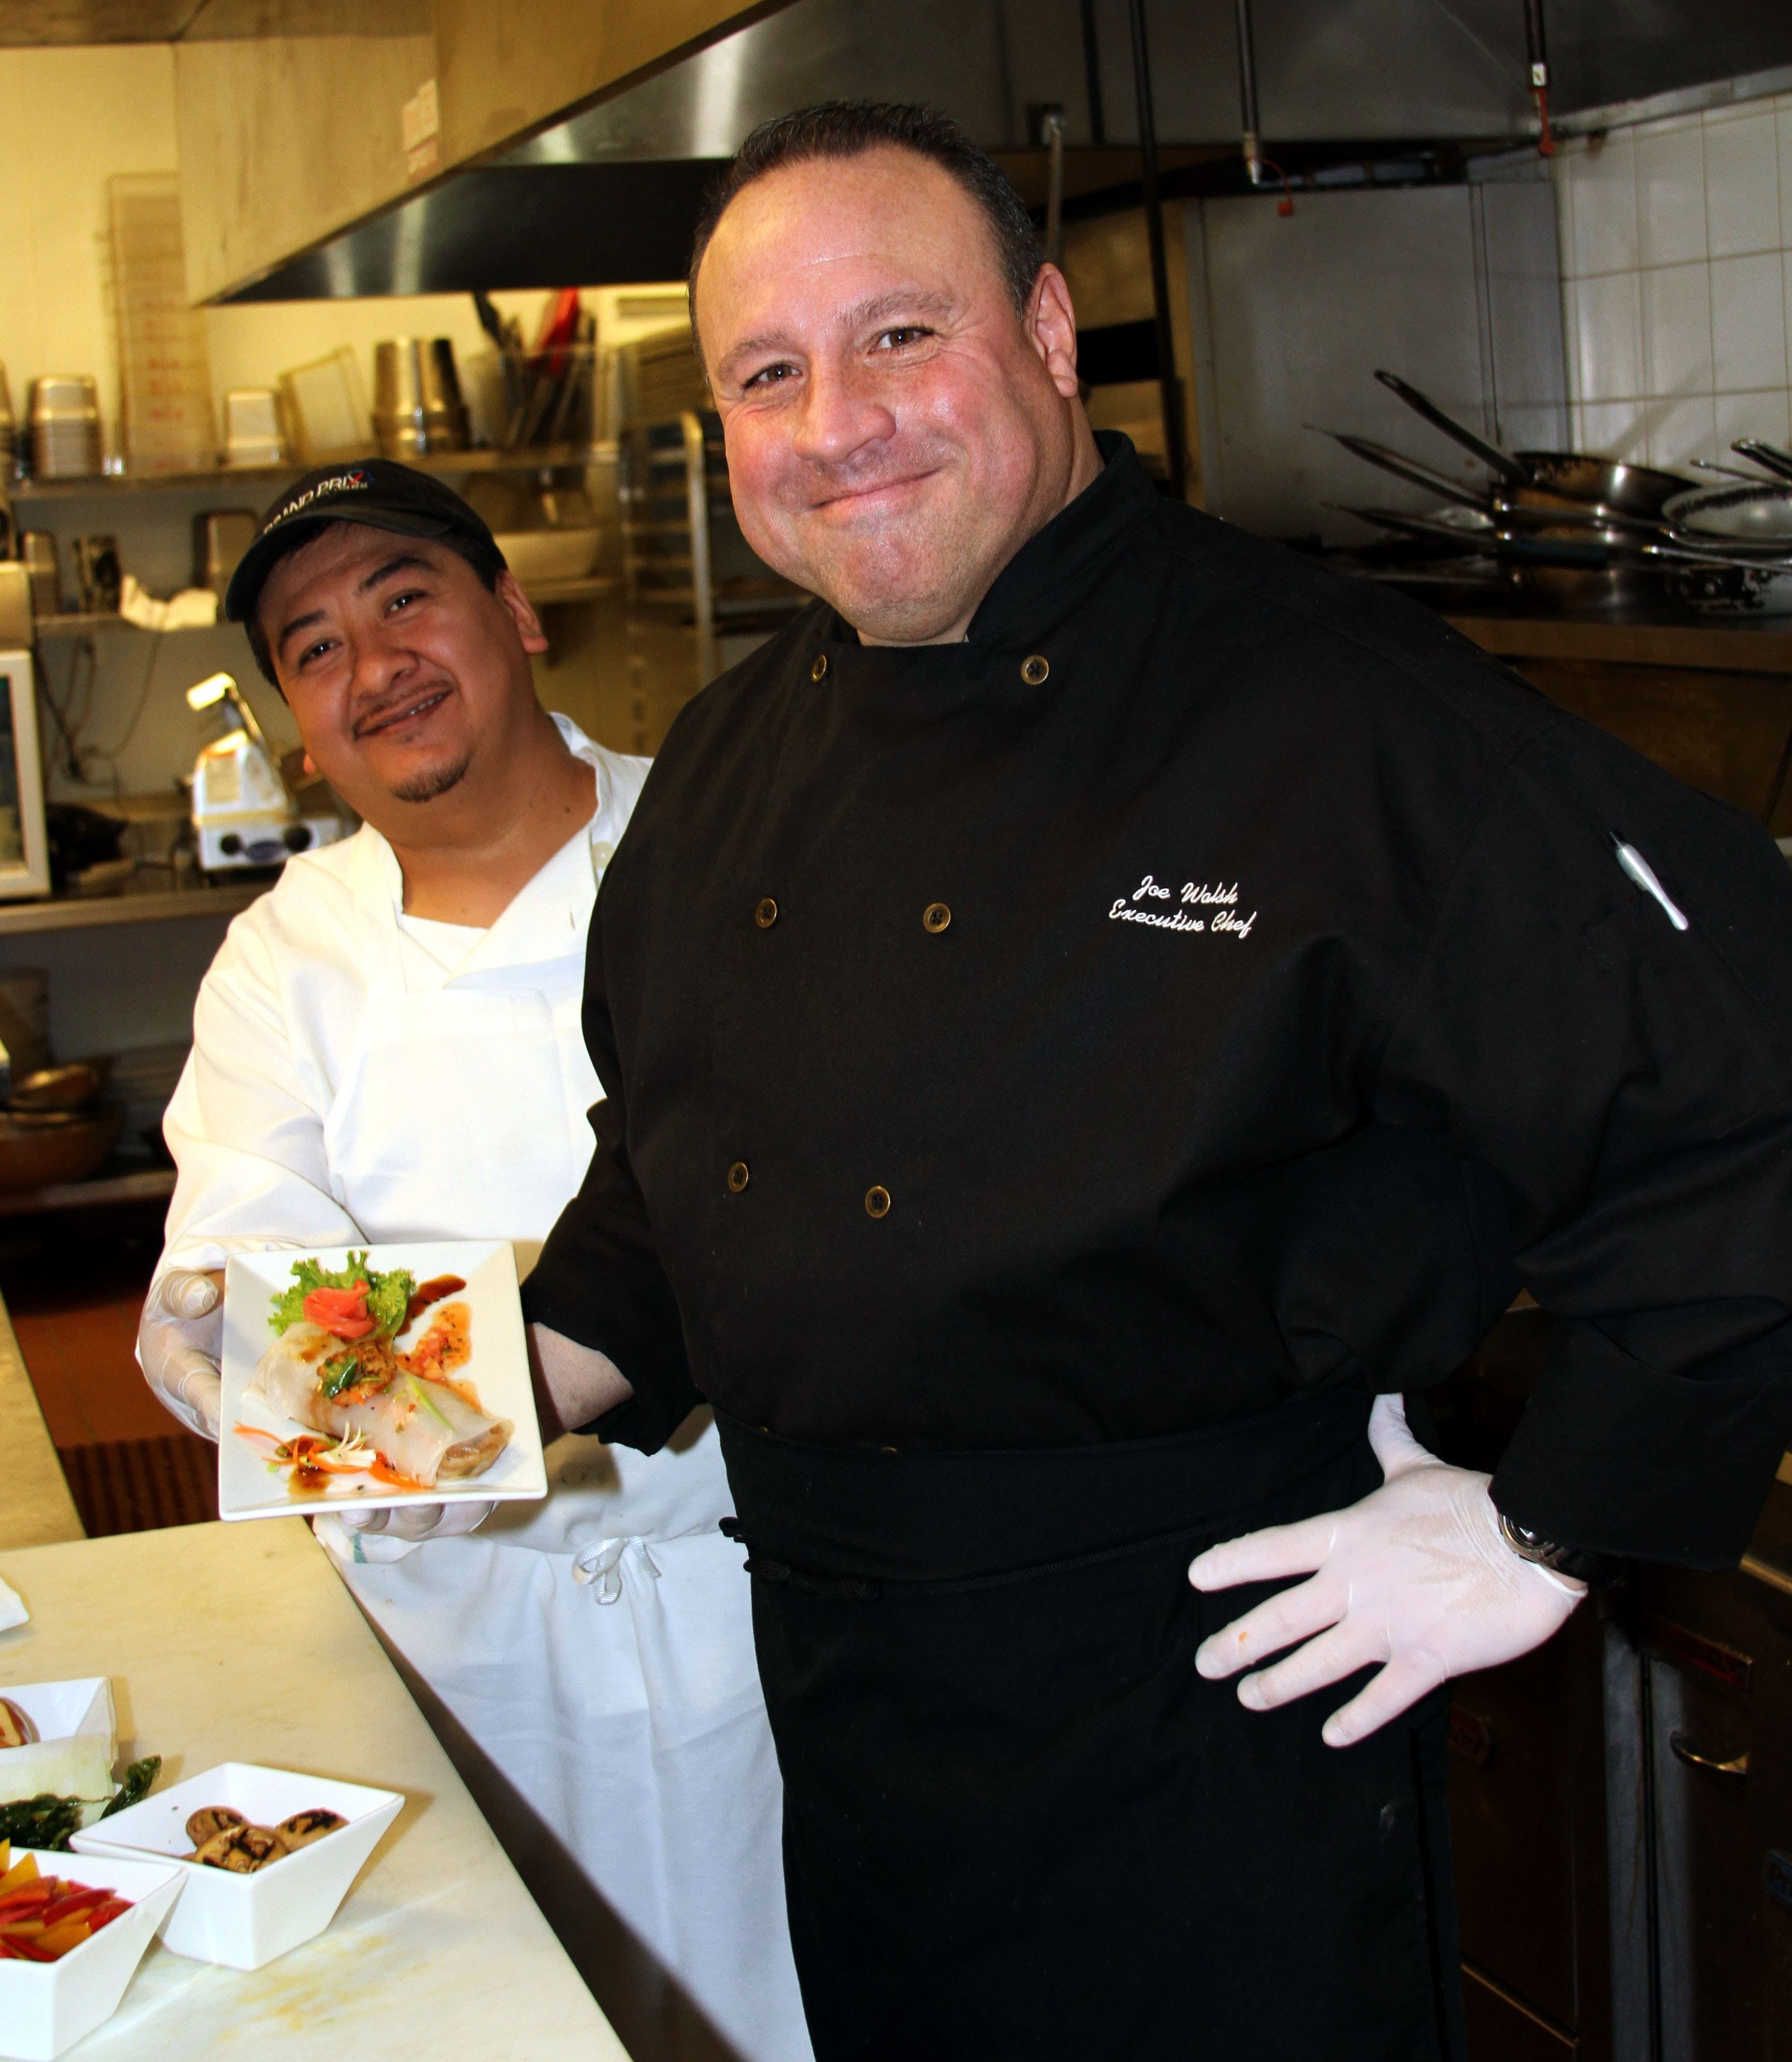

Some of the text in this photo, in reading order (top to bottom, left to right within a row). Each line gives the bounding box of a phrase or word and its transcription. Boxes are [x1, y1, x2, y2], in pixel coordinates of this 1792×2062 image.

[316, 470, 365, 498] PRIX
[1132, 875, 1238, 903] Joe Walsh
[1109, 899, 1257, 939] Executive Chef
